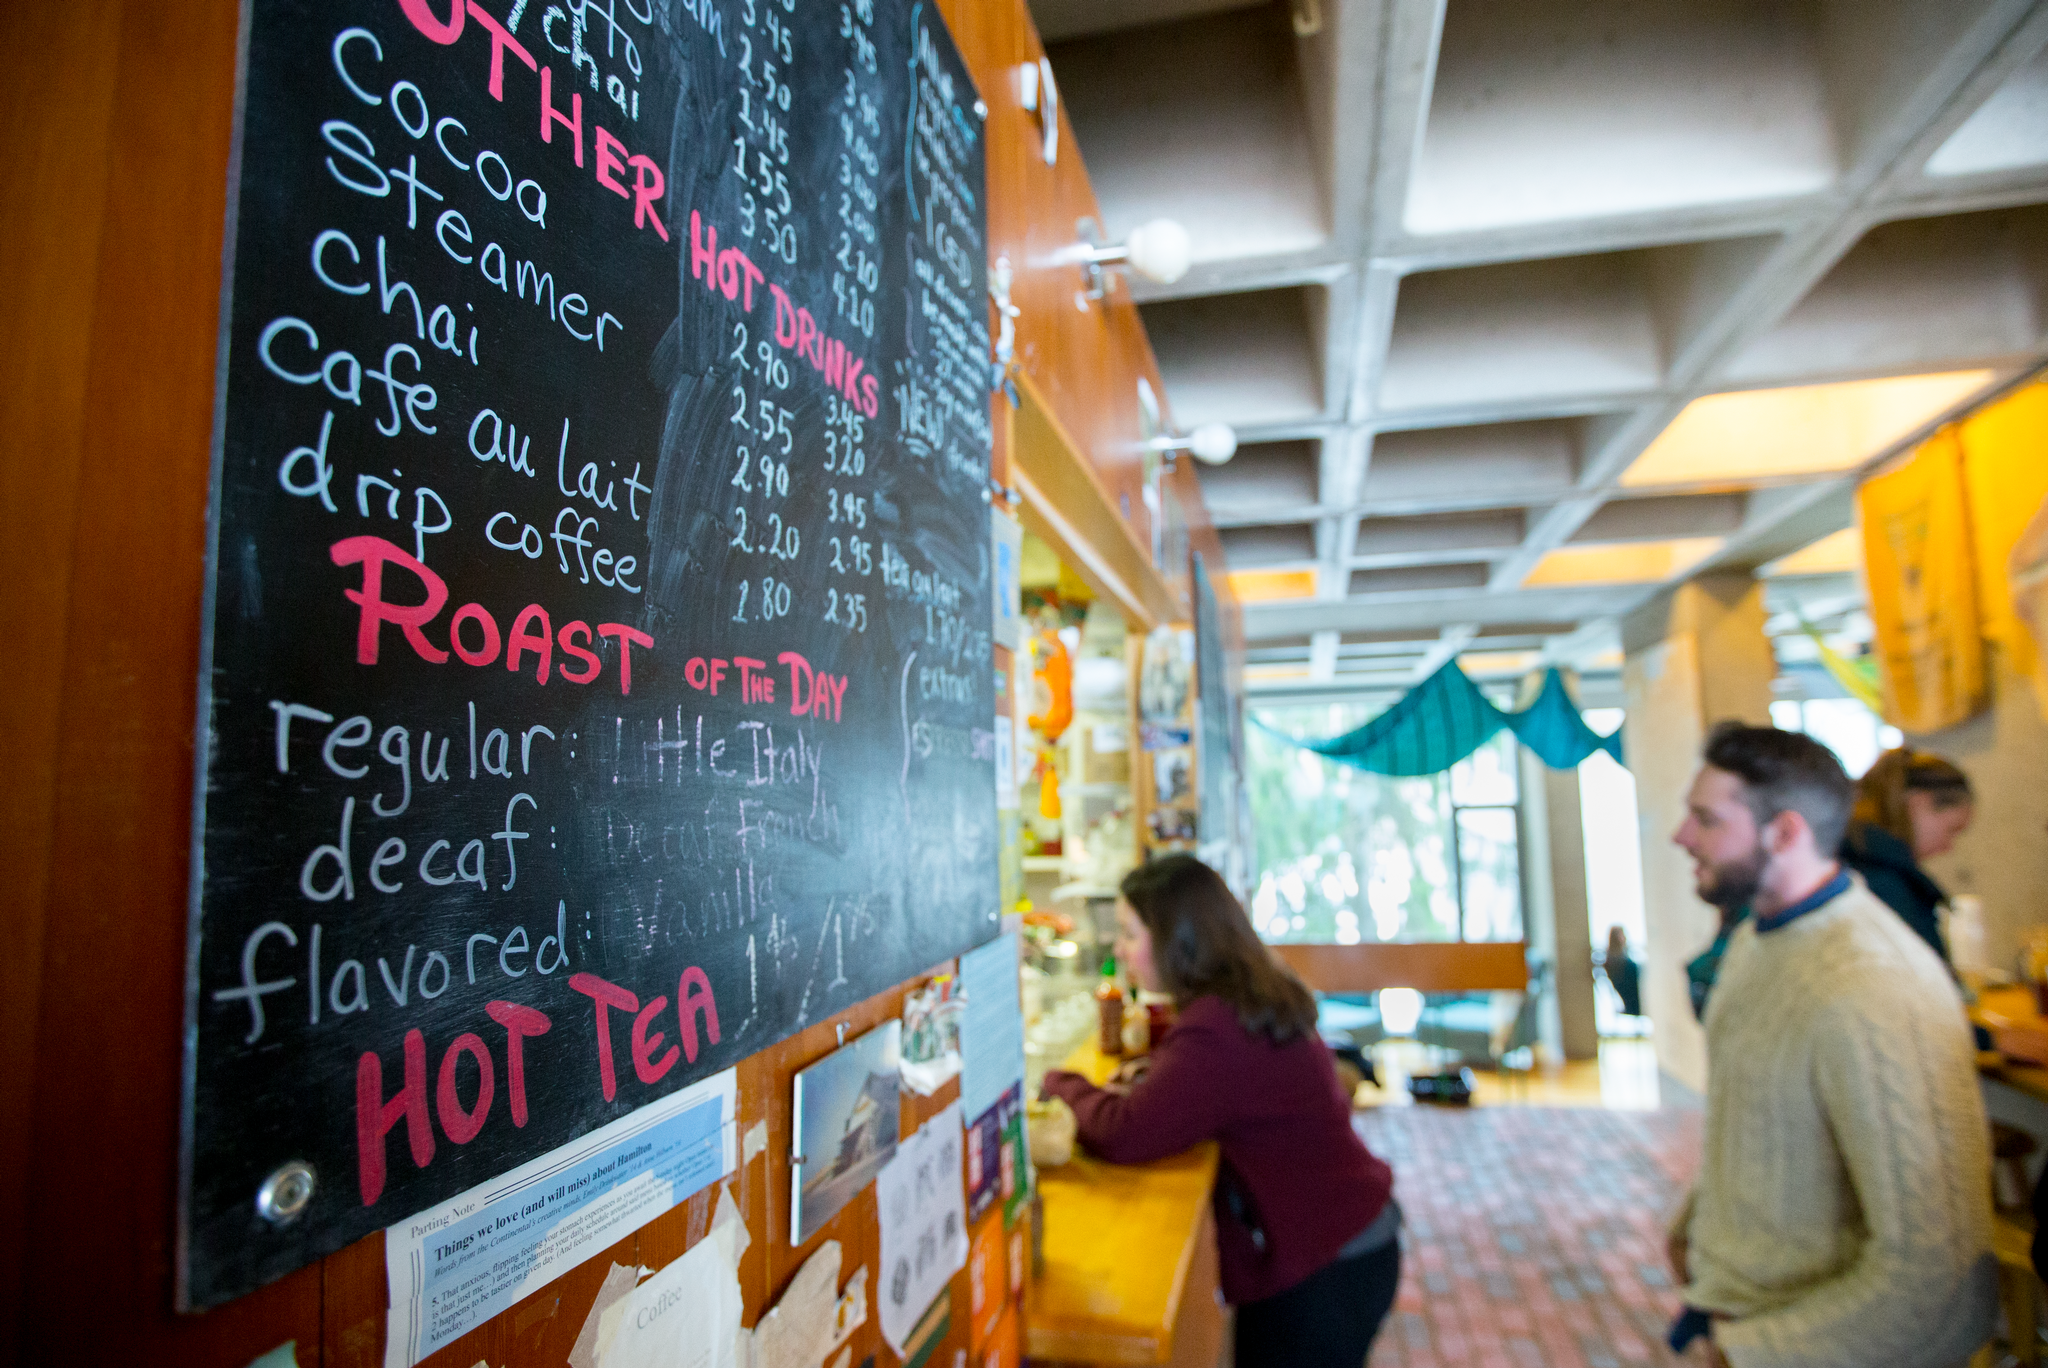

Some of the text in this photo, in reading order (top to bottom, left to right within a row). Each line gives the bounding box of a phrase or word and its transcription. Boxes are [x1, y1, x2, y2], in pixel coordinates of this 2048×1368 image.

[739, 33, 791, 112] 2.50
[739, 88, 789, 164] 1.45
[734, 137, 791, 215] 1.55
[740, 192, 797, 264] 3.50
[320, 119, 624, 353] Steamer
[731, 386, 795, 455] 2.55
[691, 209, 765, 313] HOT
[770, 283, 879, 419] DRINKS
[731, 323, 789, 389] 2.90
[468, 408, 536, 477] au
[557, 417, 653, 521] lait
[731, 506, 800, 559] 2.20
[731, 446, 789, 498] 2.90
[278, 410, 452, 564] drip
[485, 507, 642, 594] coffee
[732, 577, 791, 623] 1.80
[329, 535, 848, 724] ROAST OF THE DAY
[356, 965, 721, 1207] HOT TEA
[411, 1202, 475, 1239] Parting Note
[434, 1232, 474, 1261] Things
[477, 1223, 493, 1238] we
[496, 1210, 519, 1230] love
[521, 1196, 545, 1219] (and
[547, 1186, 565, 1203] will
[567, 1173, 591, 1194] miss)
[592, 1160, 616, 1181] about
[617, 1142, 652, 1167] Hamilton
[432, 1296, 439, 1308] 5.
[441, 1286, 459, 1302] That
[460, 1268, 491, 1292] anxious,
[492, 1253, 519, 1275] flipping
[521, 1239, 543, 1258] feeling
[544, 1231, 558, 1248] your
[560, 1215, 583, 1236] stomach
[432, 1310, 439, 1319] is
[441, 1301, 455, 1315] that
[456, 1290, 471, 1308] just
[496, 1267, 510, 1282] and
[511, 1258, 526, 1274] then
[526, 1244, 555, 1266] planning
[555, 1234, 569, 1251] your
[570, 1225, 584, 1241] daily
[434, 1260, 457, 1278] Words
[457, 1250, 476, 1269] from
[477, 1242, 489, 1255] the
[490, 1217, 536, 1248] Continental's
[537, 1205, 562, 1224] creative
[432, 1321, 437, 1332] 2
[439, 1304, 470, 1326] happens
[471, 1297, 479, 1307] to
[481, 1291, 489, 1303] be
[491, 1279, 512, 1295] tastier
[513, 1272, 522, 1283] on
[523, 1262, 541, 1280] given
[636, 1286, 682, 1330] Coffee
